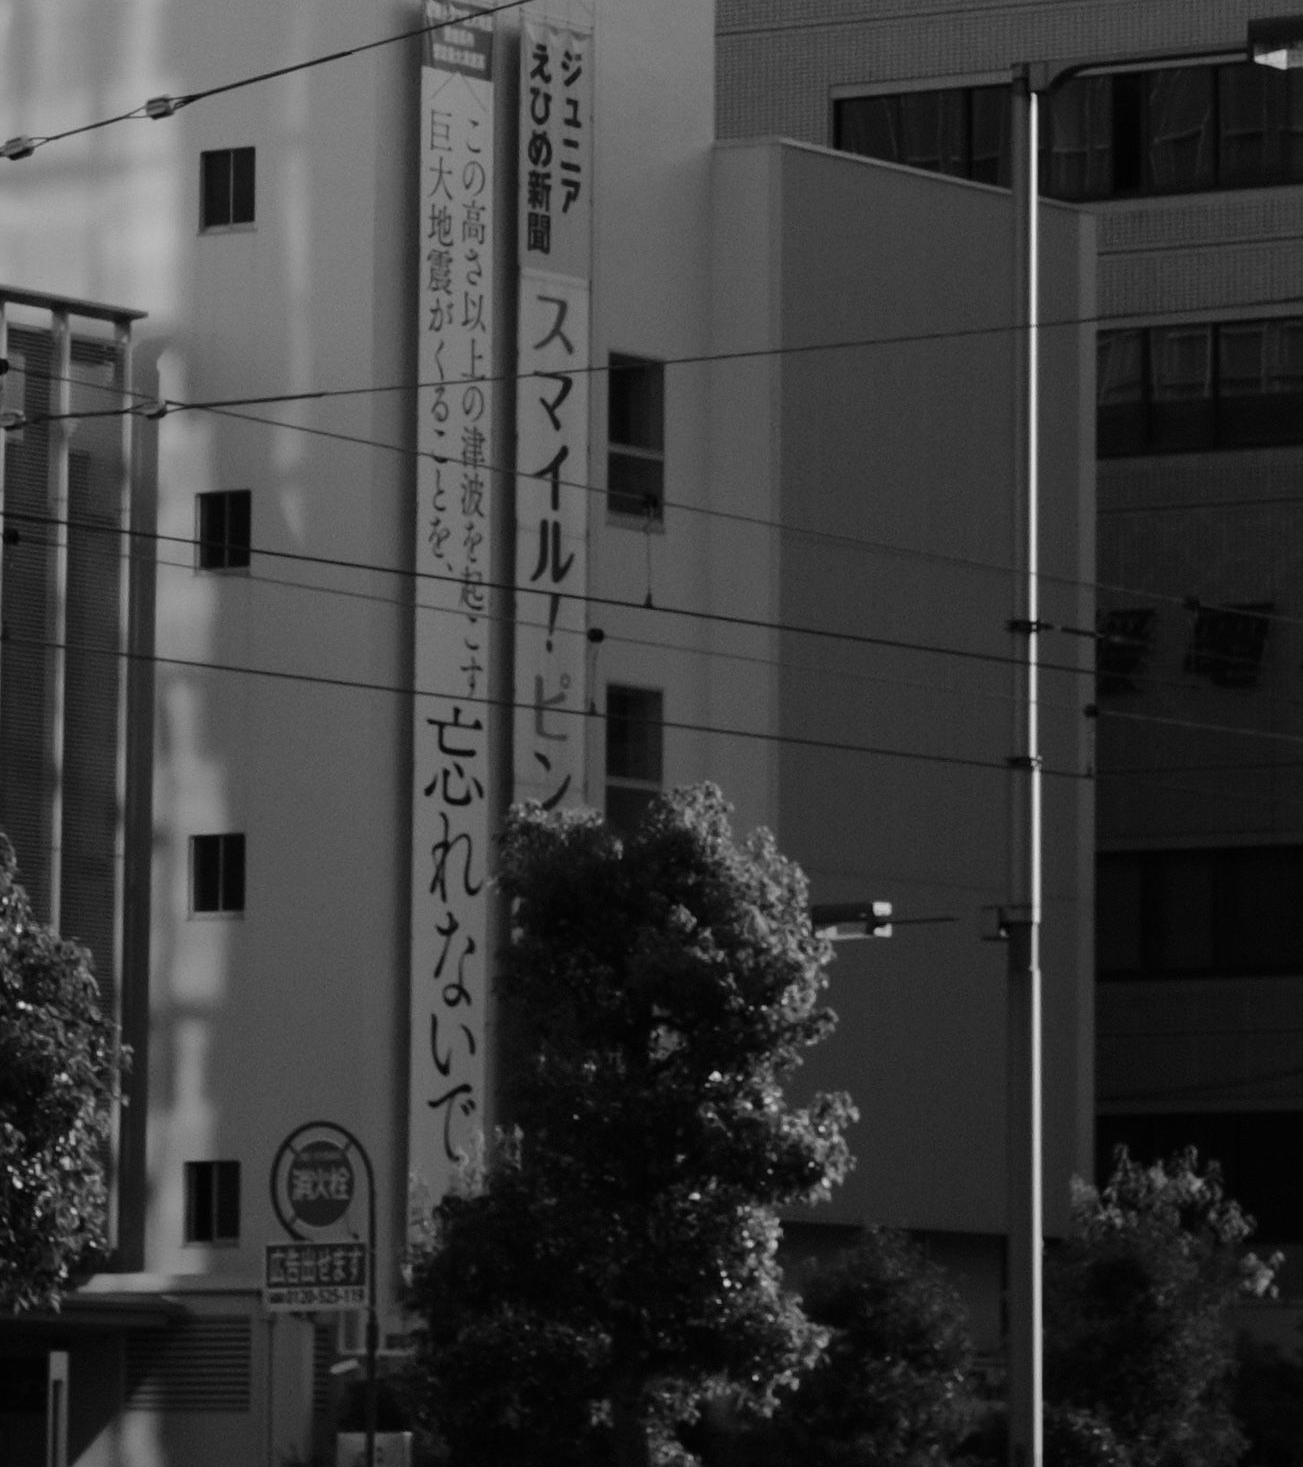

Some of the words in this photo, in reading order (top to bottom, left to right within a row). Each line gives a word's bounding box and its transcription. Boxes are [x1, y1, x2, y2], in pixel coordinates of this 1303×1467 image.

[527, 43, 553, 255] えひめ新聞
[560, 47, 582, 214] ジュニア
[423, 705, 485, 1162] 忘れないで
[293, 1167, 351, 1201] 消火栓
